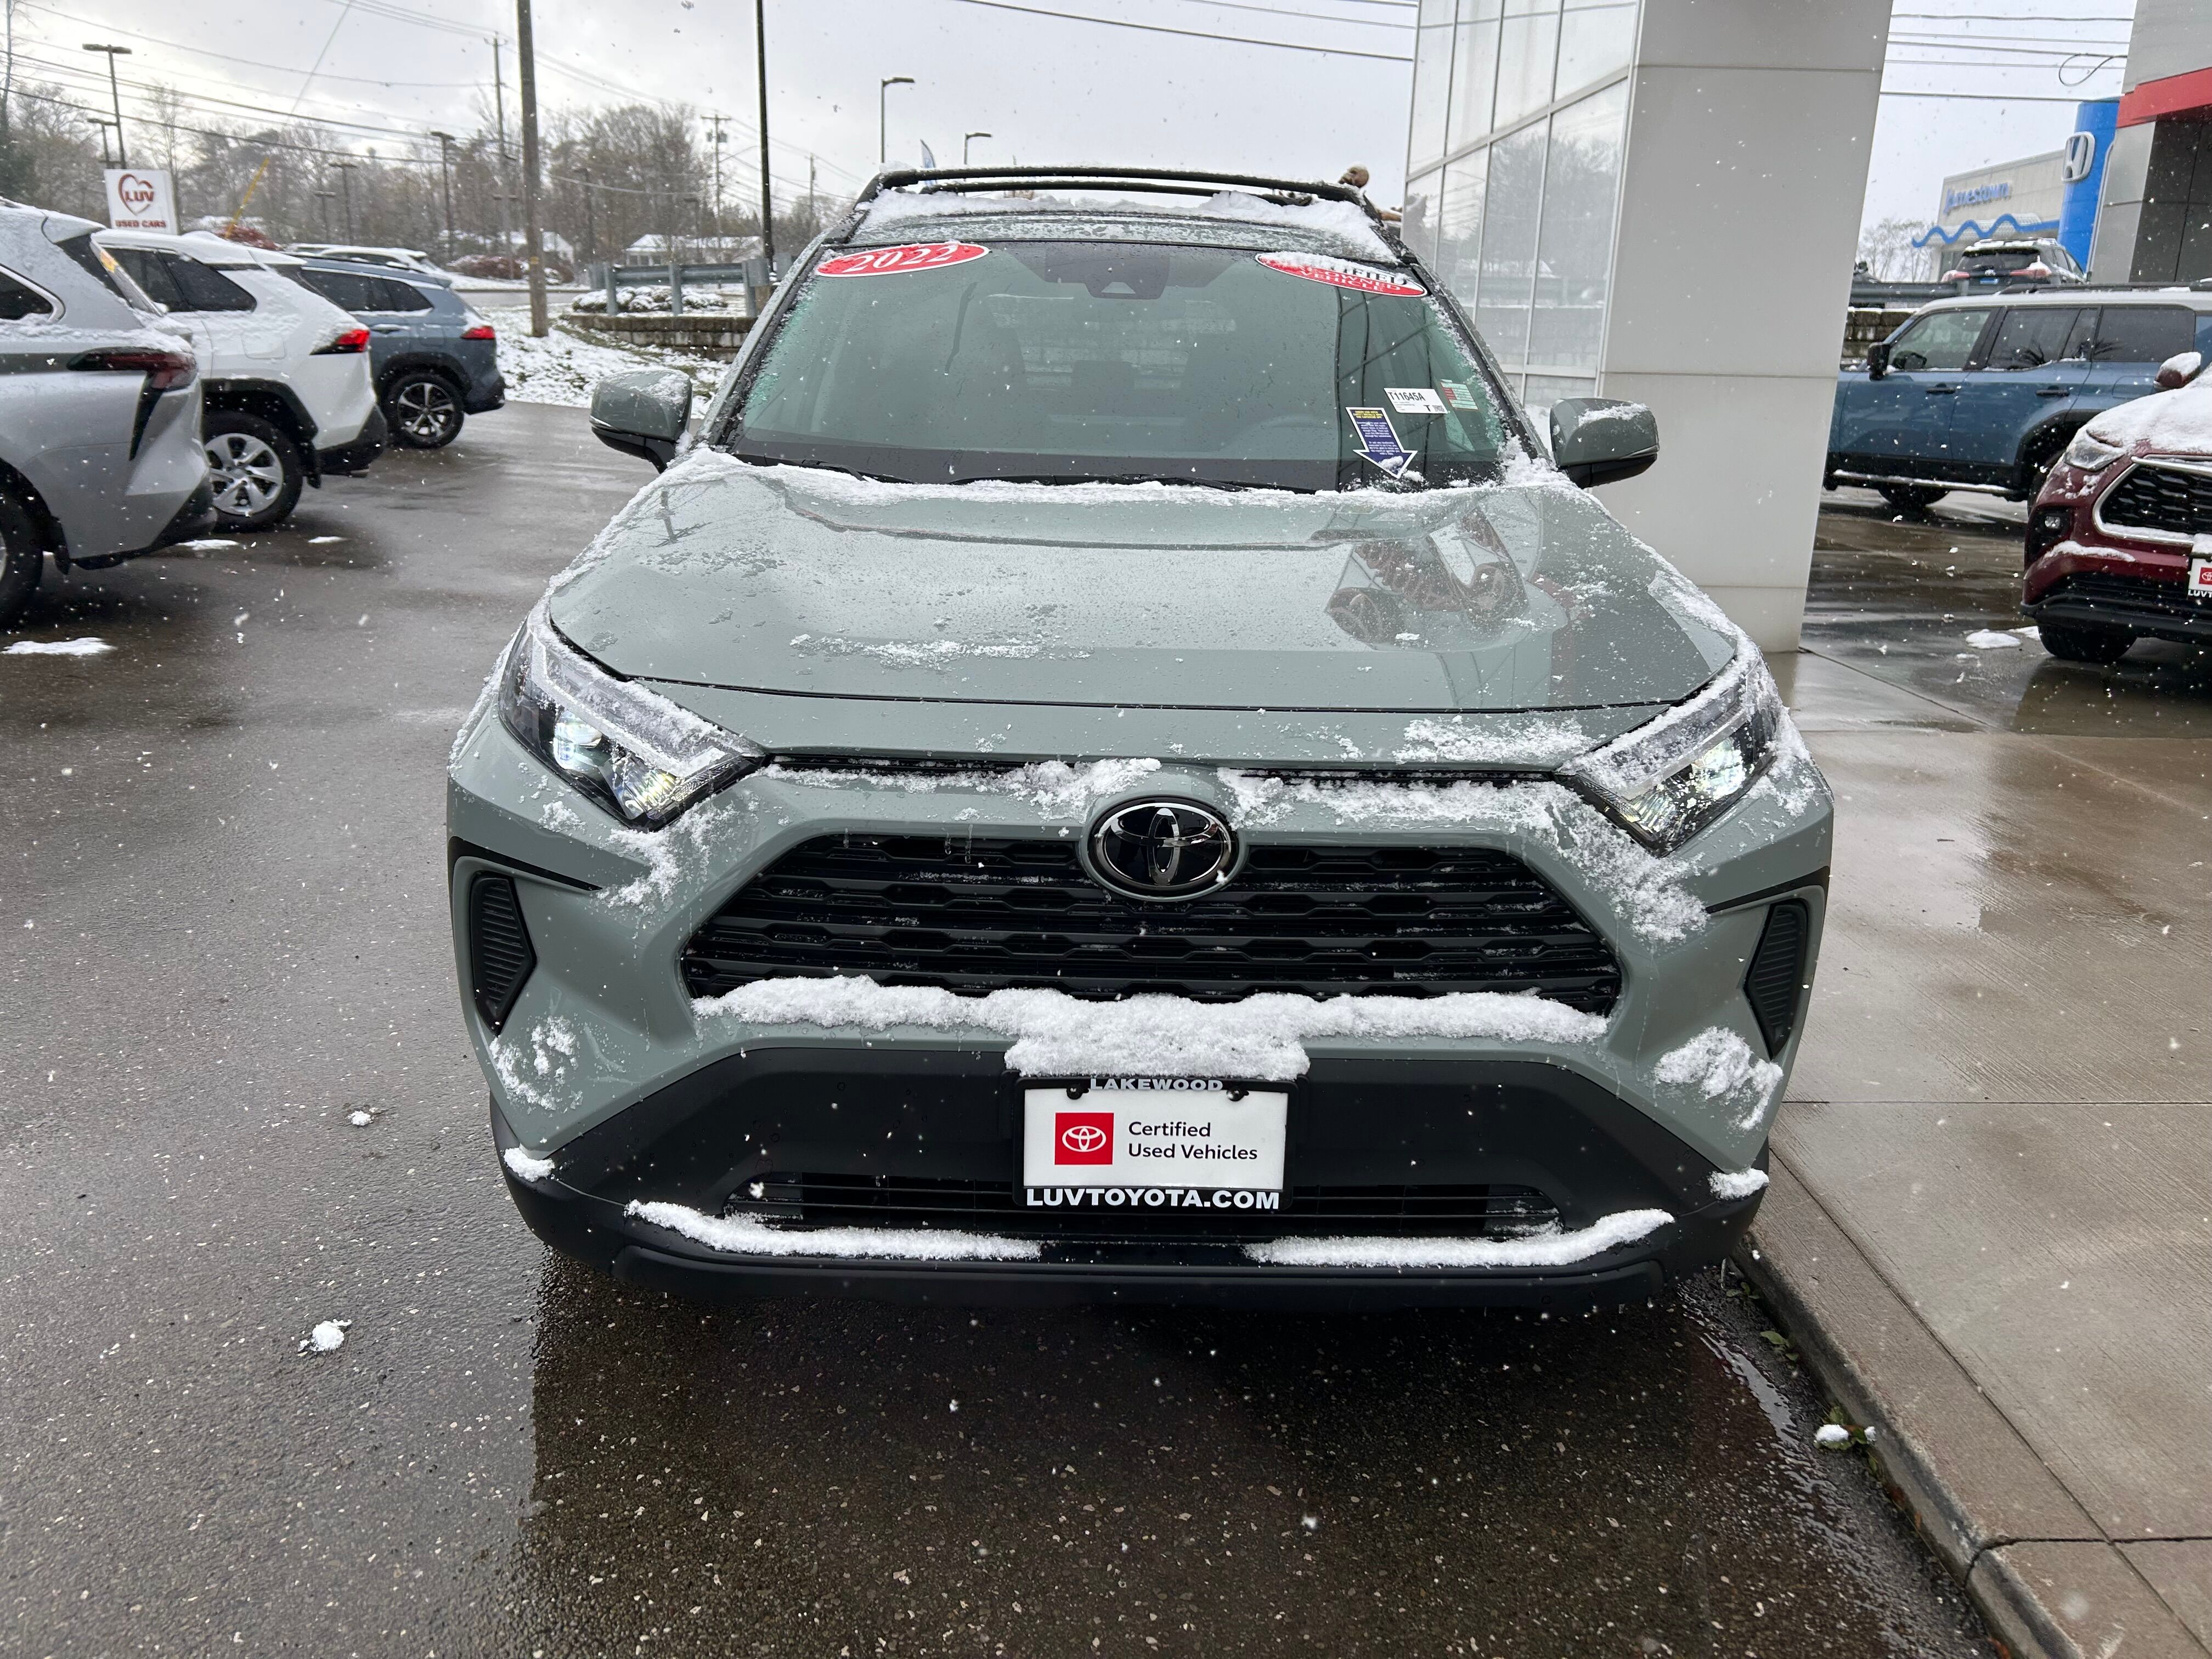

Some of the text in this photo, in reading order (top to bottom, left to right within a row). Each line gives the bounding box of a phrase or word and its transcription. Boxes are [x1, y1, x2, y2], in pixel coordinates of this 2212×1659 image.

[125, 190, 154, 202] LUV
[842, 245, 960, 273] 2022
[1300, 270, 1384, 292] VEHICLE
[1387, 392, 1426, 401] T11645A
[1090, 1078, 1223, 1091] LAKEWOOD
[1128, 1121, 1211, 1137] Certified
[1128, 1143, 1258, 1160] Used Vehicles
[1026, 1188, 1280, 1210] LUVTOYOTA.COM
